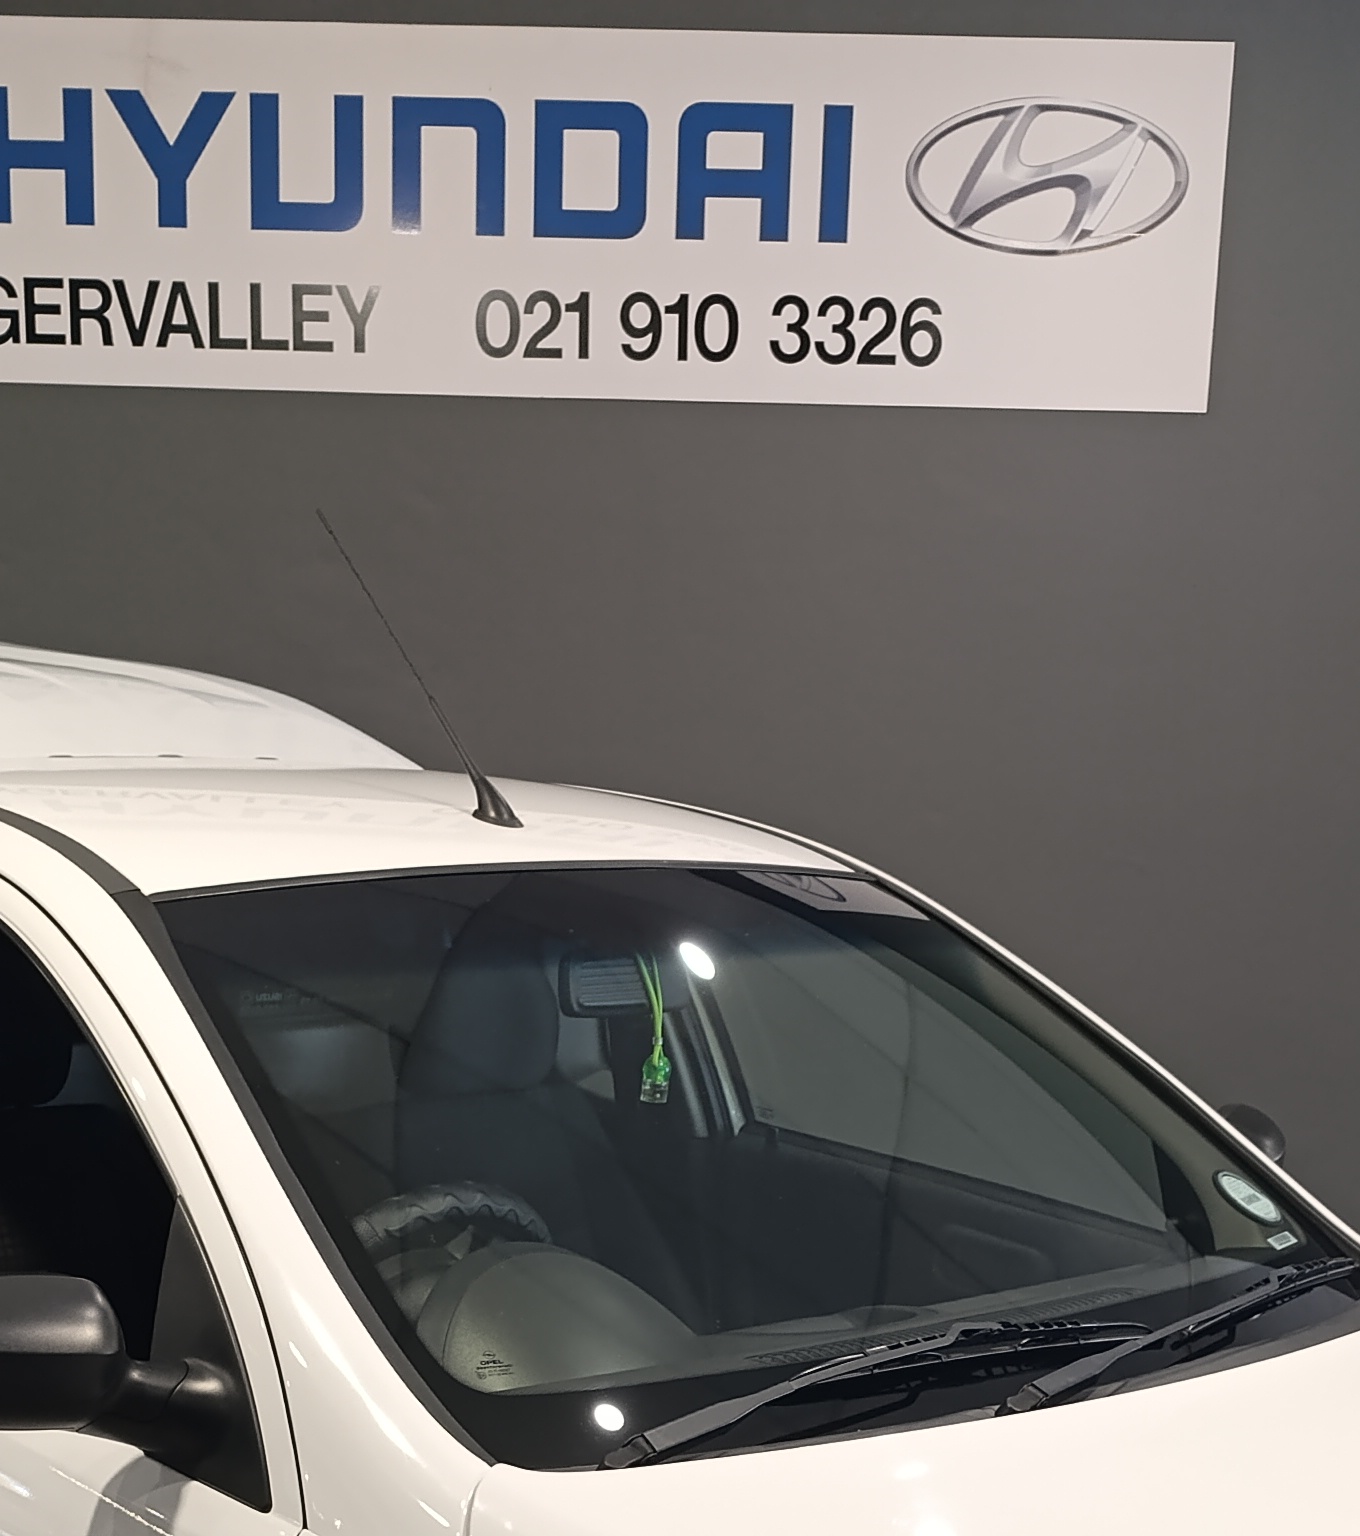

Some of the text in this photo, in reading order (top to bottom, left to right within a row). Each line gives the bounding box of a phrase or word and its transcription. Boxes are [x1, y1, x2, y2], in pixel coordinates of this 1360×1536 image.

[475, 289, 590, 360] 021
[619, 291, 739, 363] 910
[769, 294, 943, 368] 3326
